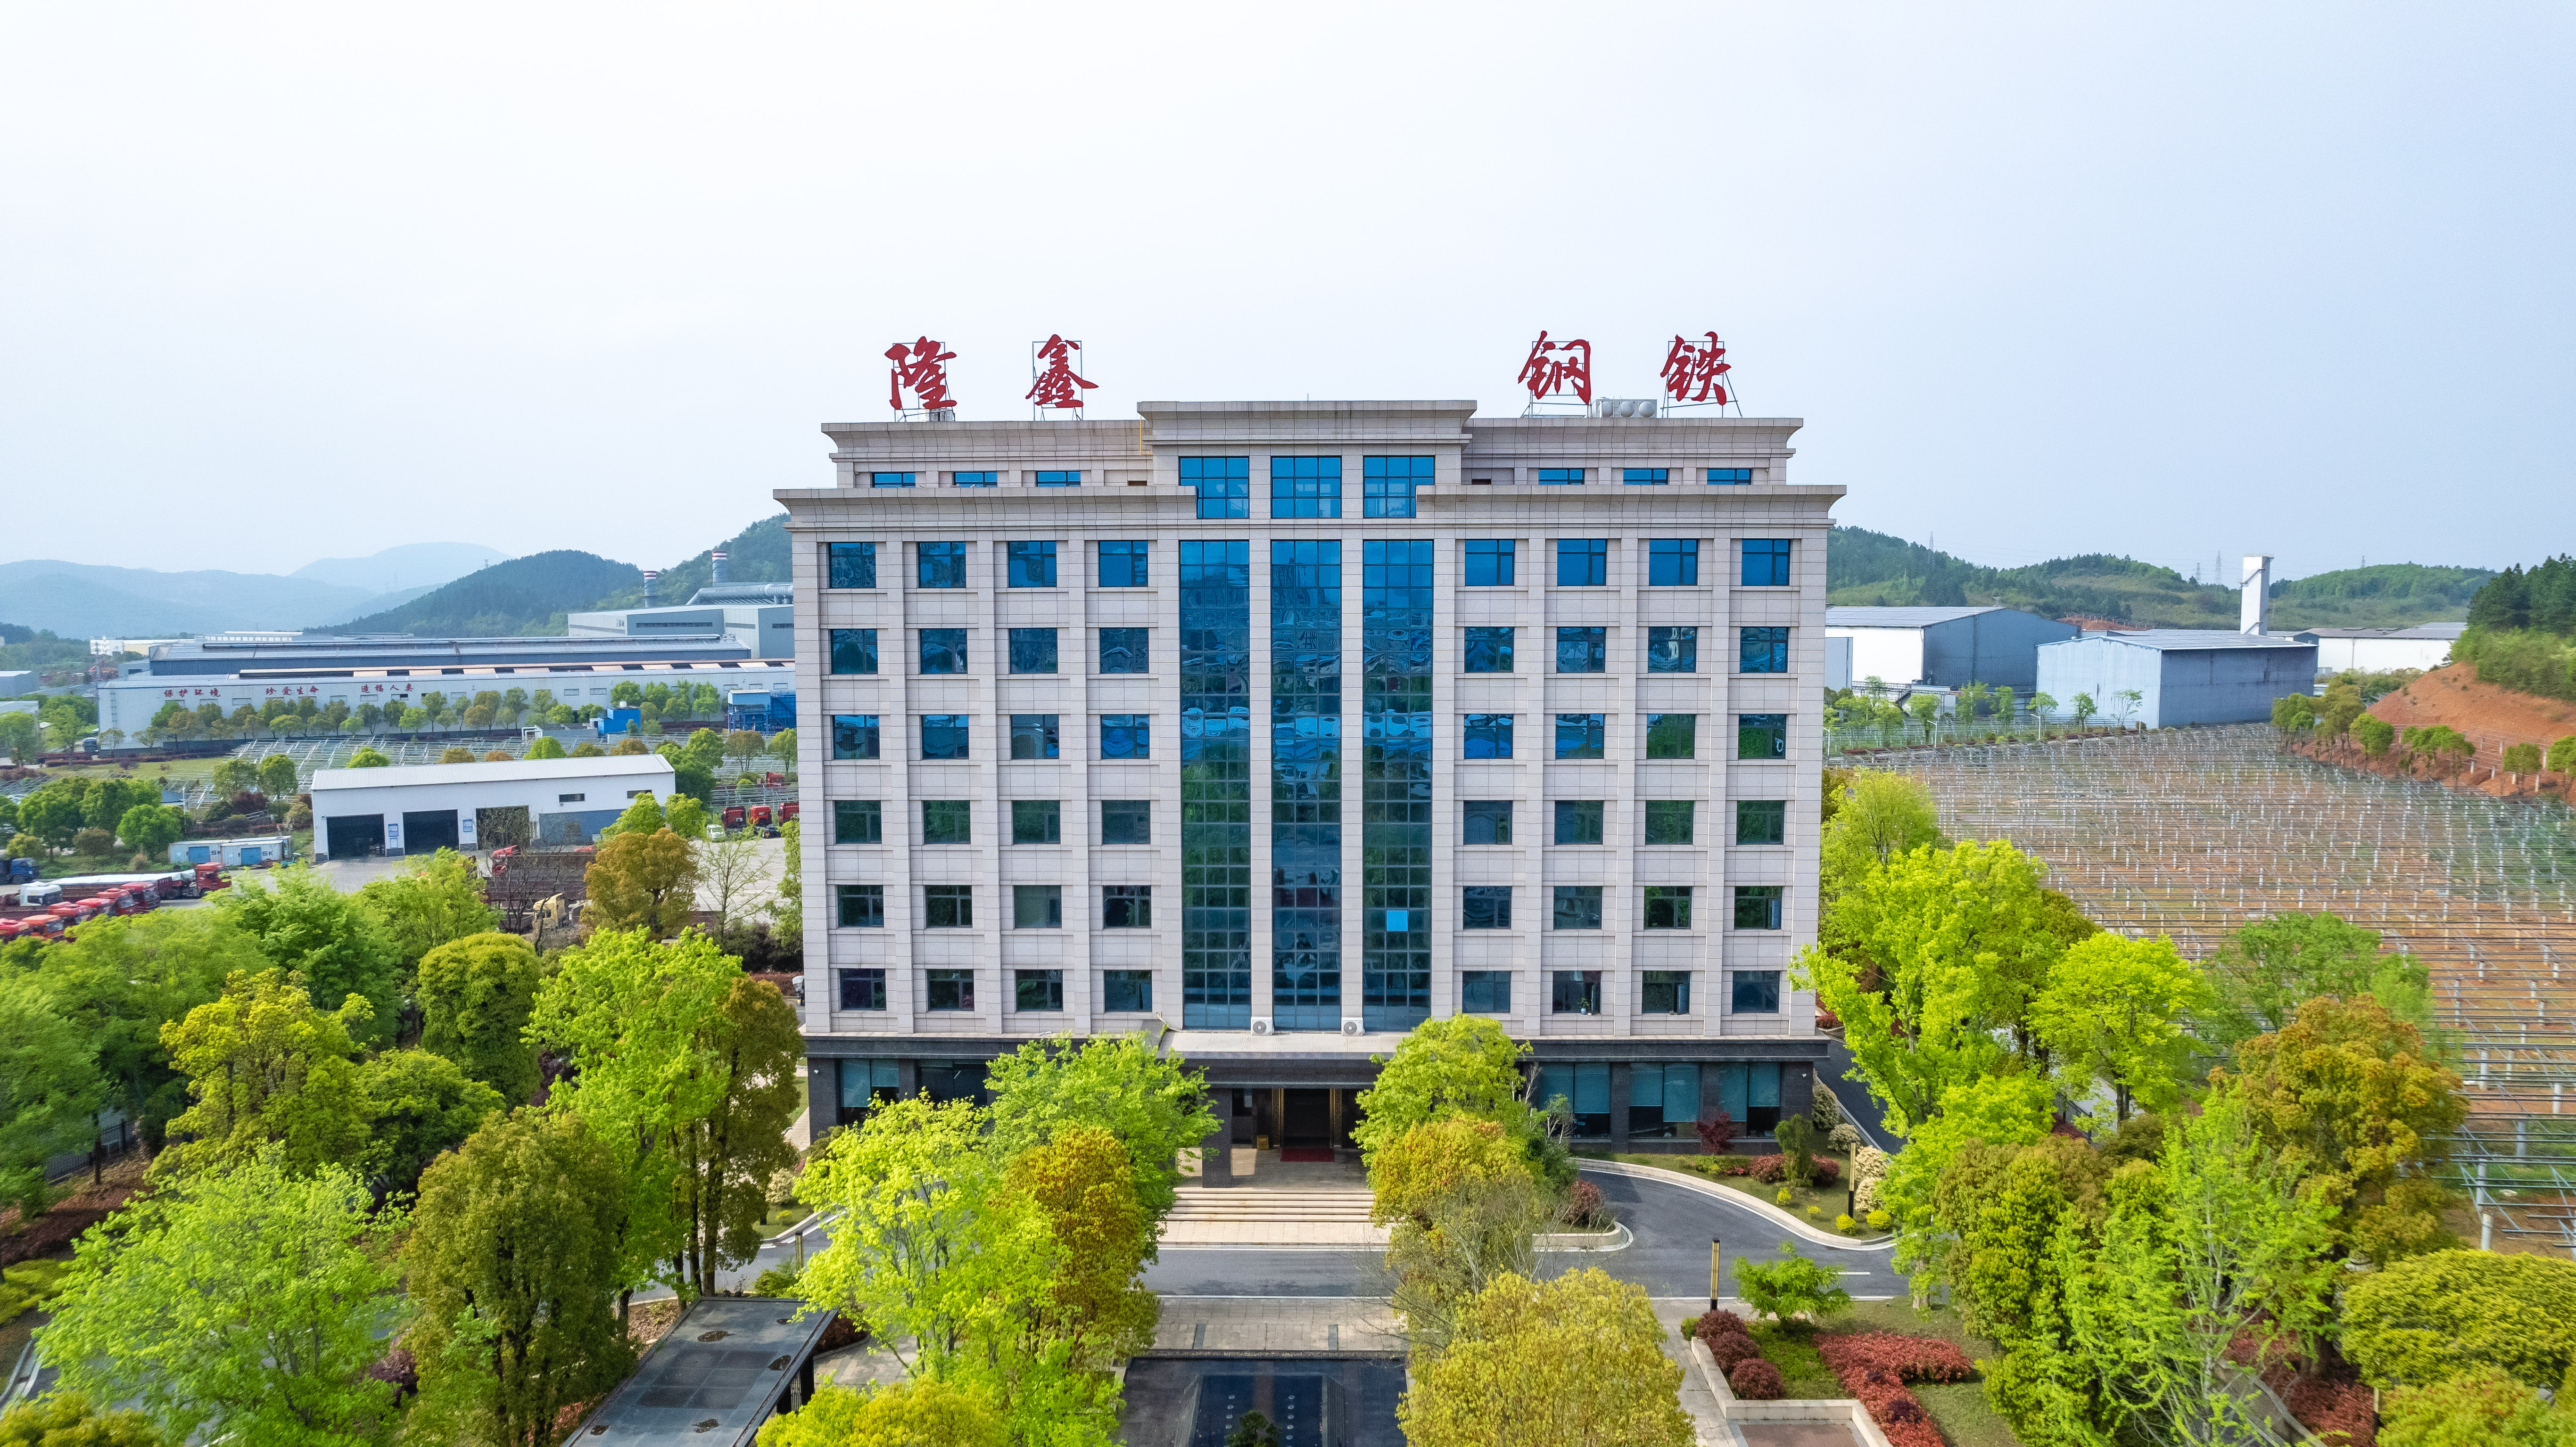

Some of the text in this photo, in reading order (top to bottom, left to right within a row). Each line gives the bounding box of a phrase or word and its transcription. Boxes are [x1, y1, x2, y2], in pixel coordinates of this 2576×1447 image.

[884, 330, 1732, 410] 隆鑫 钢铁
[164, 683, 413, 697] 保护环境 珍爱生命 造福人类
